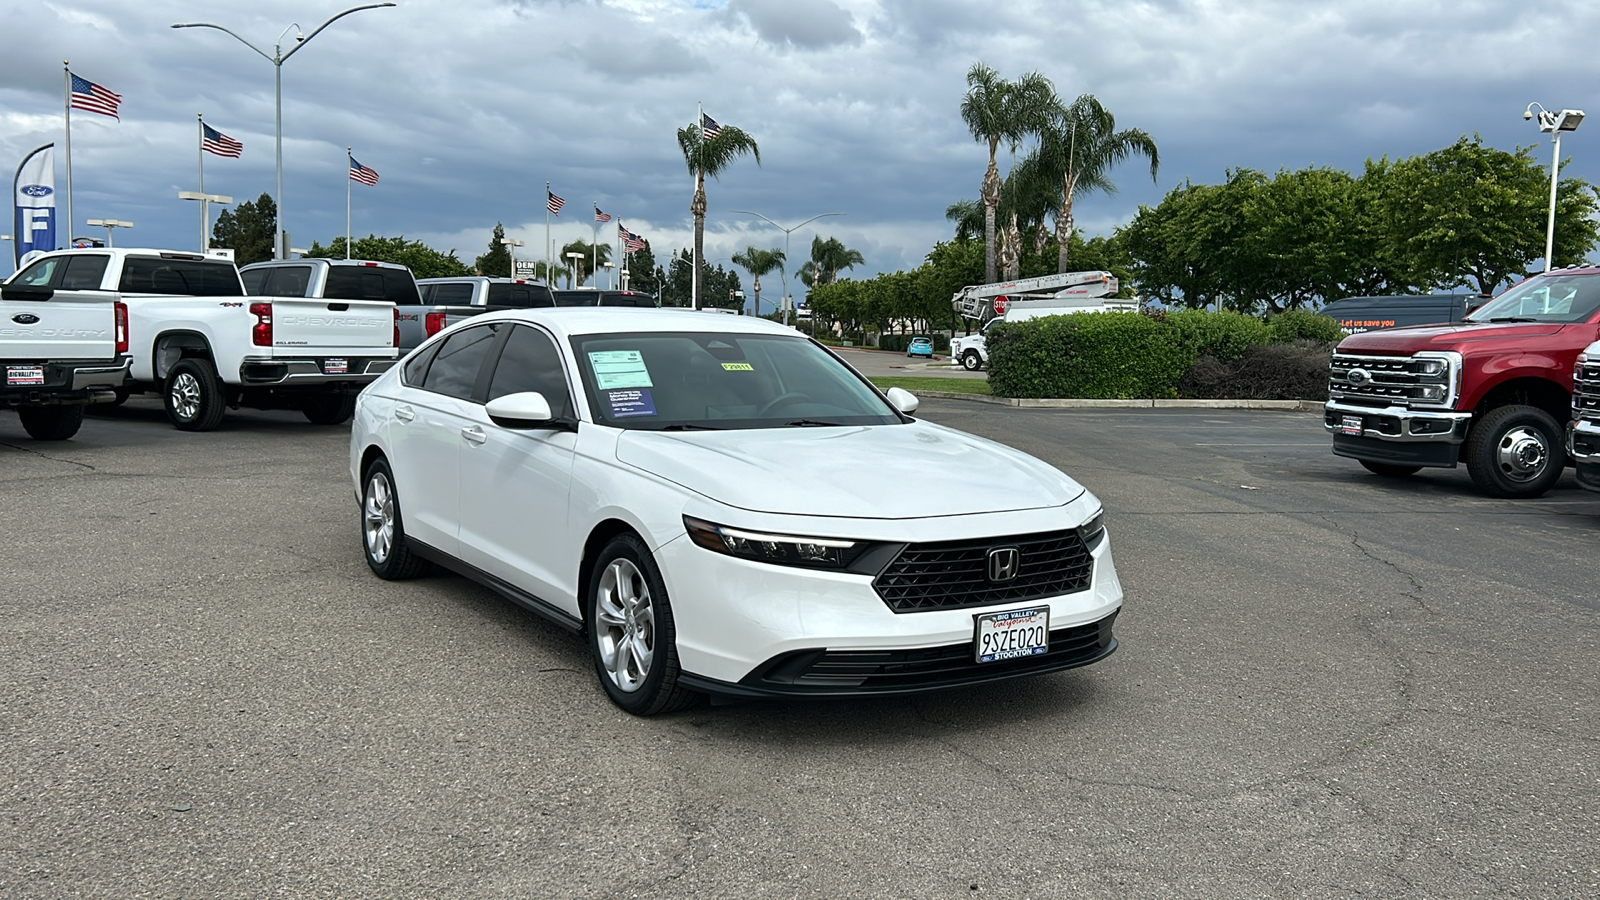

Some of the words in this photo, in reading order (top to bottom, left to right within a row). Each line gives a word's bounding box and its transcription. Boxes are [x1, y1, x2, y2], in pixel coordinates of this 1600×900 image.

[516, 261, 535, 269] OEM
[282, 315, 388, 328] CHEVROLET
[1341, 319, 1353, 327] Let
[1381, 320, 1395, 328] you
[41, 328, 107, 337] DUTY
[1010, 611, 1034, 619] VALLEY
[993, 617, 1036, 629] California
[982, 626, 1044, 654] 9SZE020
[994, 649, 1032, 660] STOCKTON
